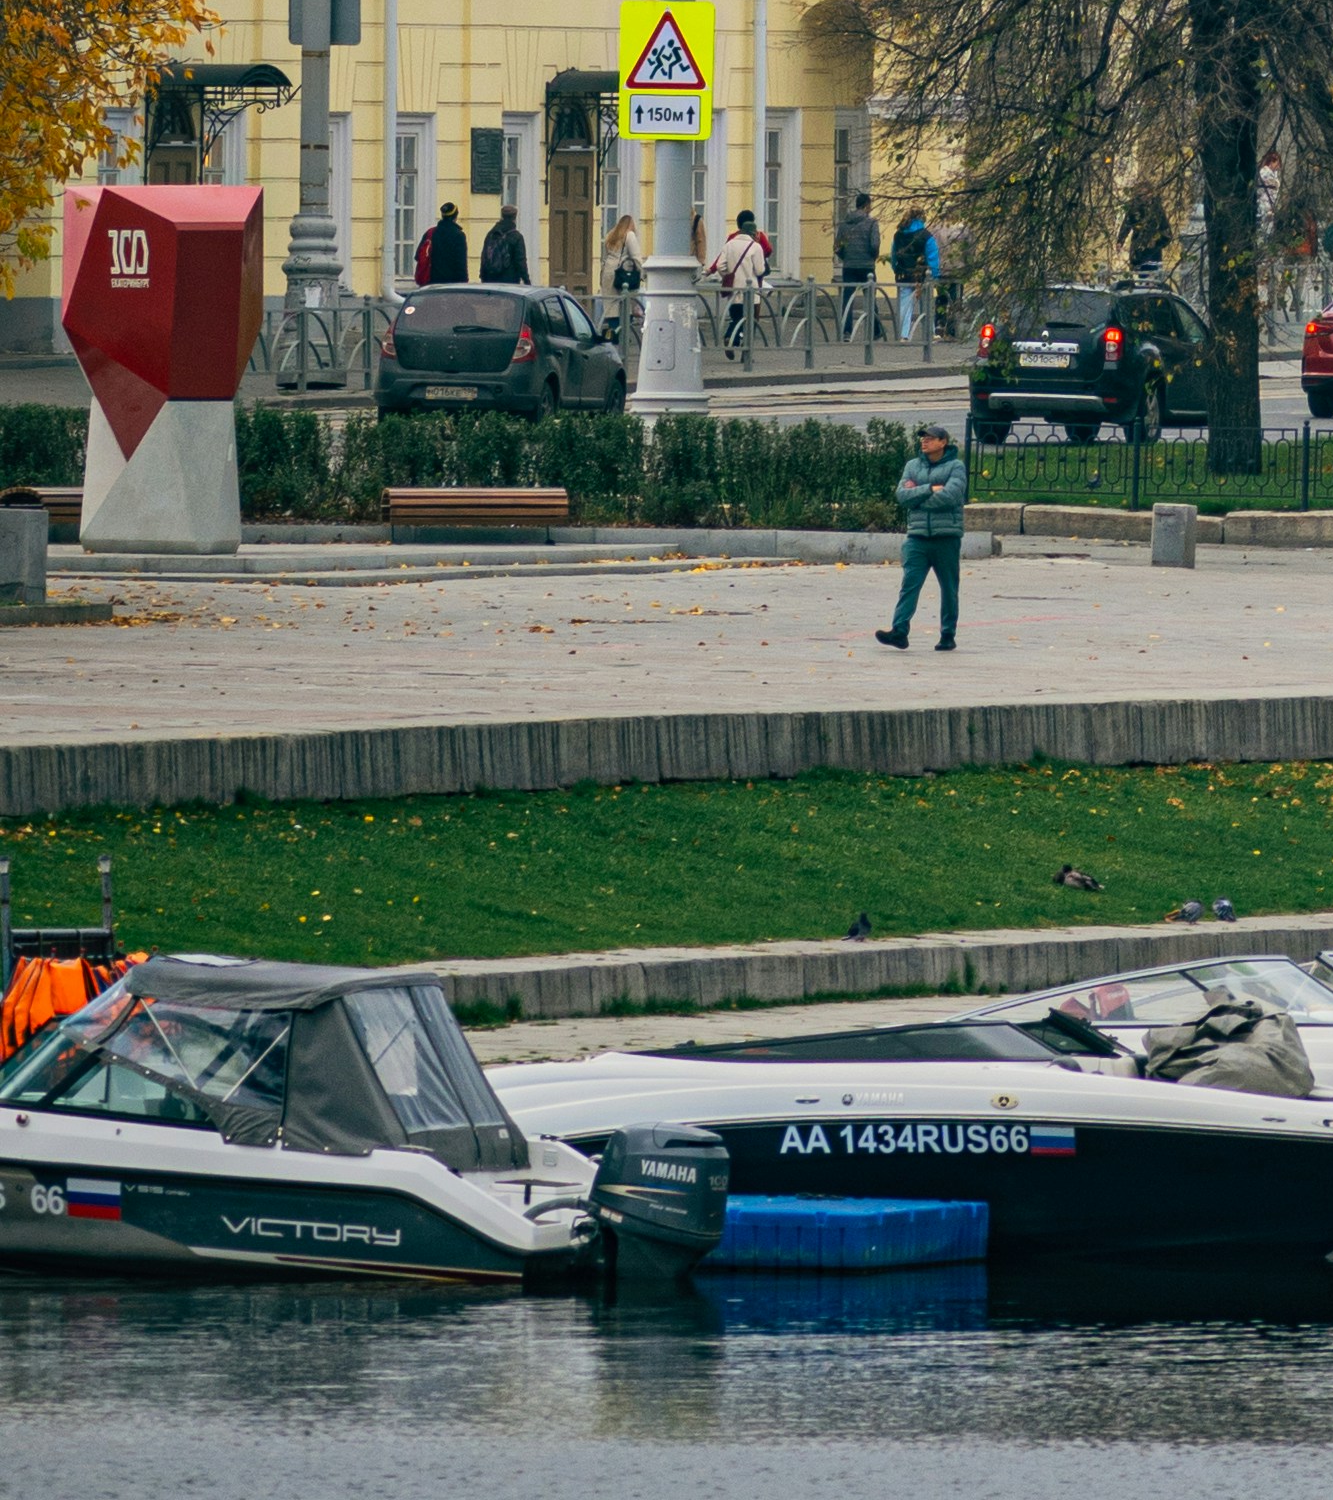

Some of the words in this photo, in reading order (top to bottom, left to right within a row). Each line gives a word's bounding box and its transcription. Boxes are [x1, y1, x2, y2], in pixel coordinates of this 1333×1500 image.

[647, 107, 684, 122] 150м
[856, 1092, 905, 1106] YAMAHA
[780, 1125, 831, 1154] AA
[840, 1125, 1029, 1154] 1434RUS66
[641, 1159, 697, 1184] YAMAHA
[30, 1184, 65, 1215] 66
[221, 1216, 400, 1246] VICTORY
